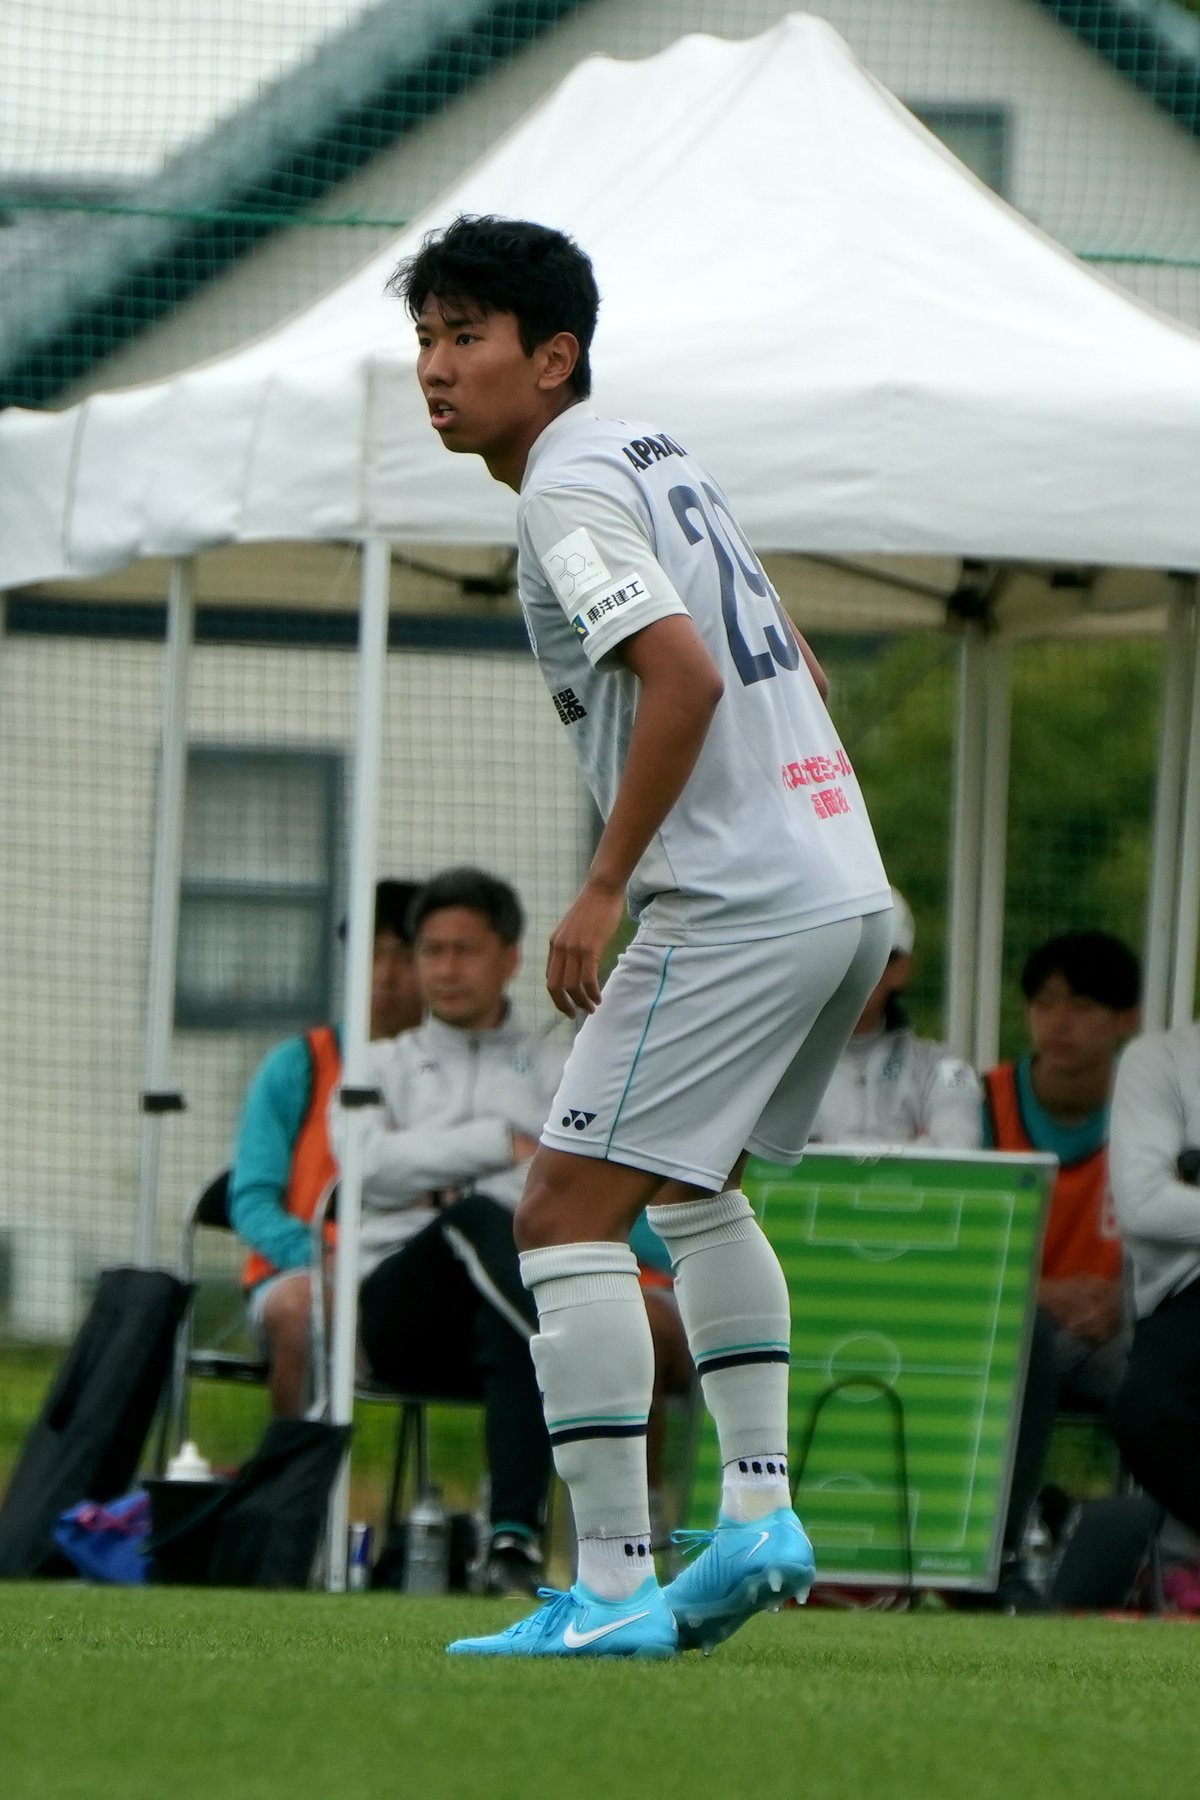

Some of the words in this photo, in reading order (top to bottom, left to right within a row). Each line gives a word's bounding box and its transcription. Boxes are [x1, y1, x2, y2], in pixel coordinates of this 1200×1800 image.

[586, 580, 645, 625] 東洋建工
[668, 480, 800, 687] 29
